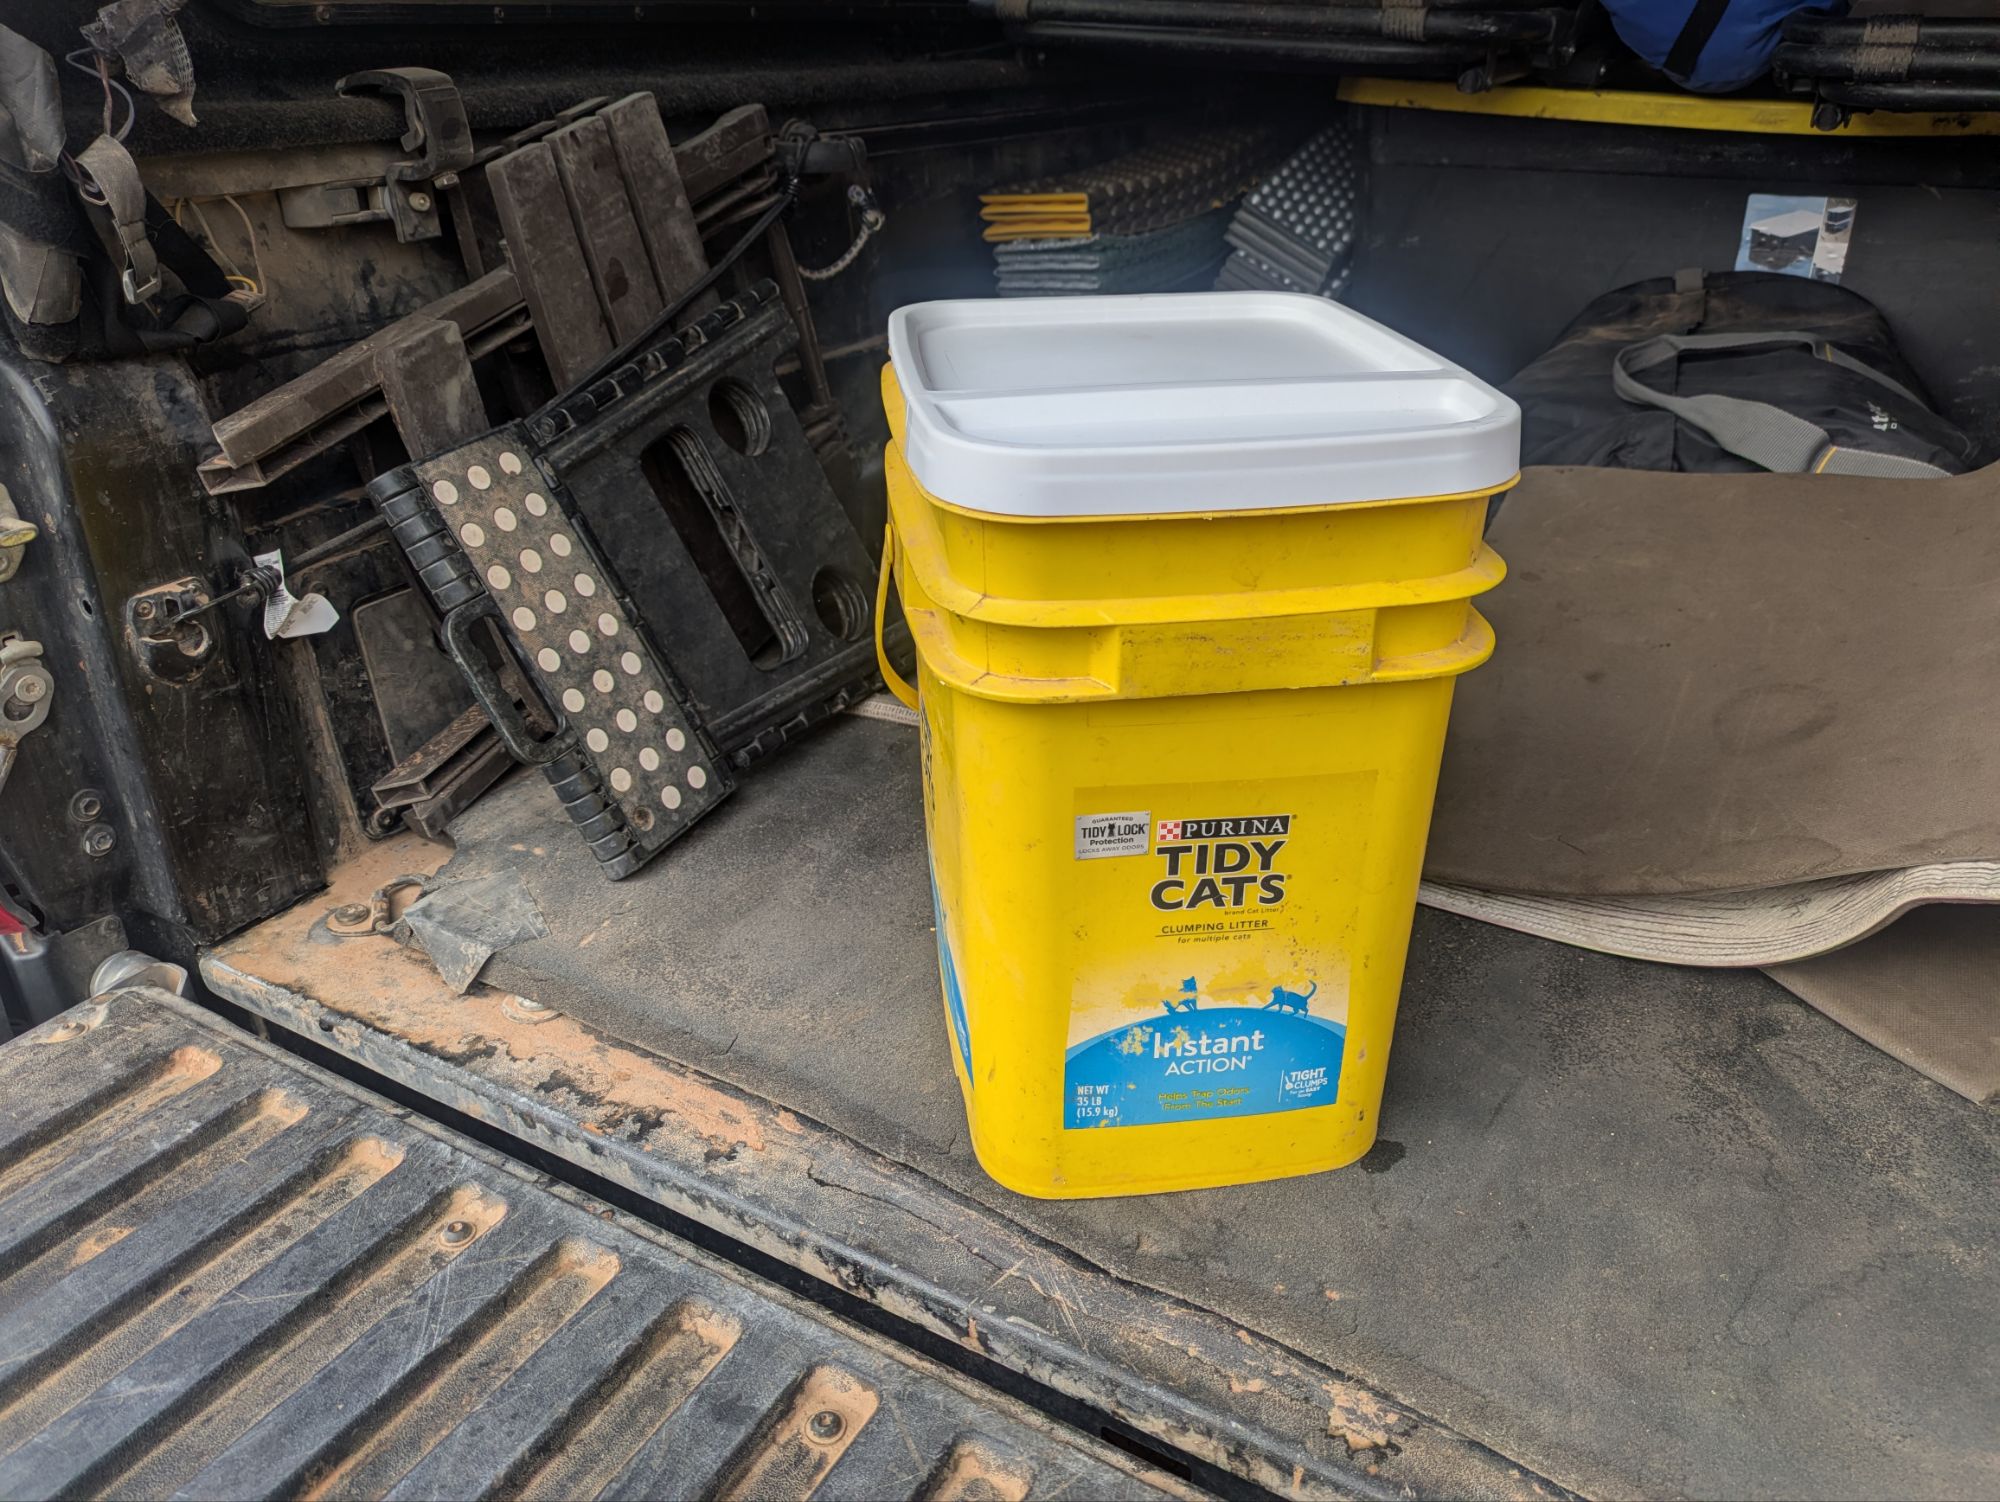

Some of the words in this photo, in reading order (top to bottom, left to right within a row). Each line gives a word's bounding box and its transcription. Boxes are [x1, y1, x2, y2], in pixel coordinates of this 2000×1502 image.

[1092, 816, 1134, 824] GUARANTEED
[1081, 826, 1107, 838] TIDY
[1118, 823, 1145, 836] LOCK
[1185, 818, 1285, 838] PURINA
[1089, 837, 1134, 846] Protection
[1156, 840, 1287, 876] TIDY
[1150, 873, 1285, 911] CATS
[1161, 922, 1224, 934] CLUMPING
[1229, 919, 1269, 930] LITTER
[1177, 936, 1191, 945] for
[1193, 934, 1230, 943] multiple
[1153, 1030, 1265, 1059] Instant
[1164, 1056, 1247, 1076] ACTION
[1291, 1067, 1326, 1082] TIGHT
[1077, 1085, 1093, 1095] NET
[1096, 1085, 1110, 1095] WT
[1294, 1078, 1328, 1089] CLUMPS
[1077, 1096, 1089, 1106] 35
[1091, 1096, 1102, 1106] LB
[1077, 1107, 1101, 1118] (15.9
[1103, 1106, 1118, 1118] kg)
